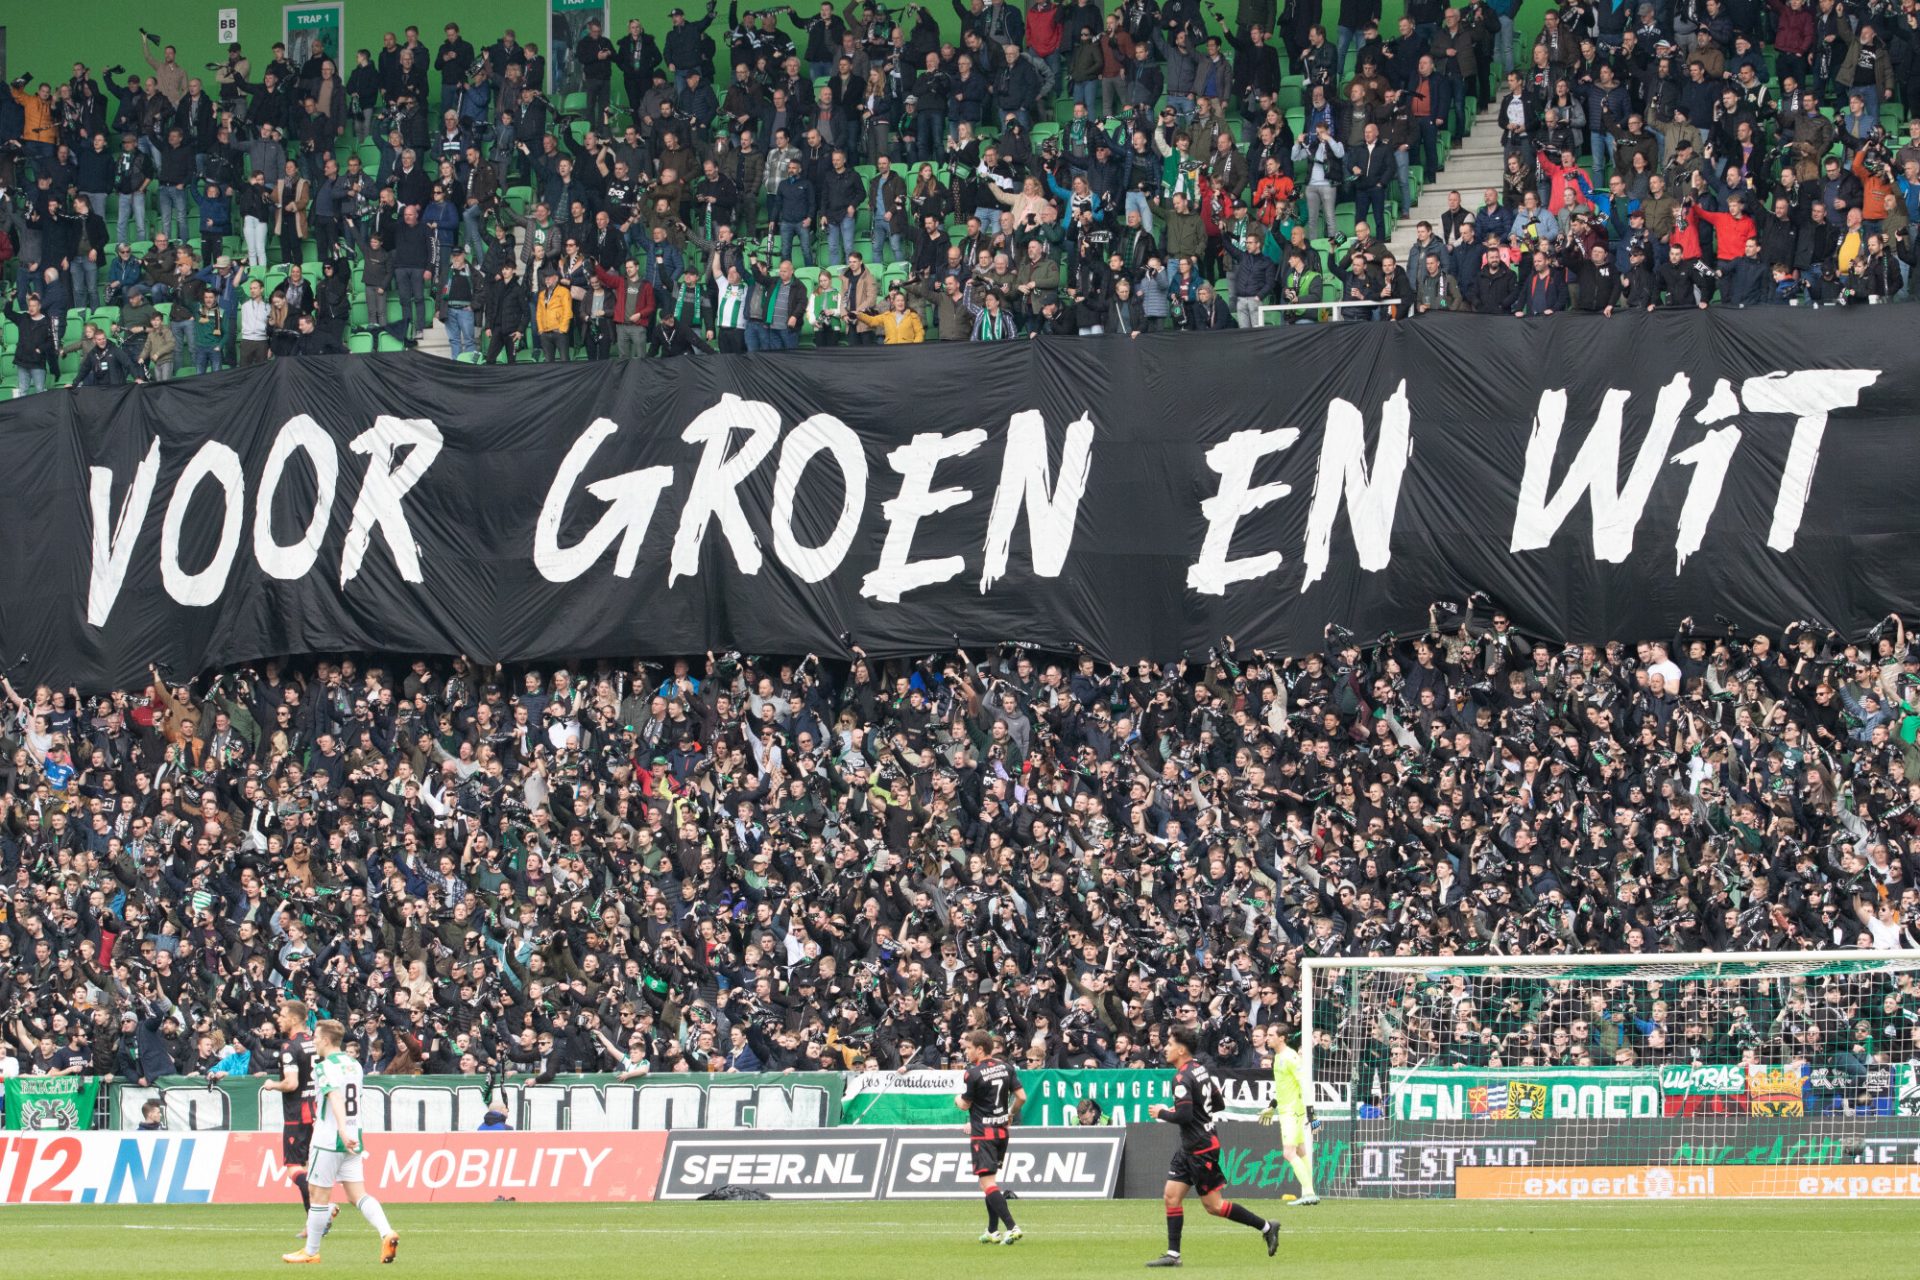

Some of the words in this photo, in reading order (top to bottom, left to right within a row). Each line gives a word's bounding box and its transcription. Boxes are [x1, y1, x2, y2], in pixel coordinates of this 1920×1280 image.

[220, 19, 236, 29] BB
[297, 14, 322, 24] TRAP
[324, 14, 330, 23] 1
[87, 413, 443, 627] VOOR
[534, 393, 1094, 604] GROEN
[1187, 379, 1412, 595] EN
[20, 1077, 79, 1095] BRIGATA
[991, 1079, 1003, 1106] 7
[1042, 1080, 1170, 1099] GRONINGEN
[1663, 1066, 1745, 1089] ULTRAS
[345, 1083, 358, 1117] 8
[0, 1137, 210, 1203] 12.NL
[379, 1149, 612, 1189] MOBILITY
[680, 1154, 864, 1185] SFEER.NL
[906, 1152, 1095, 1184] SFER.NL
[1362, 1147, 1406, 1178] DE
